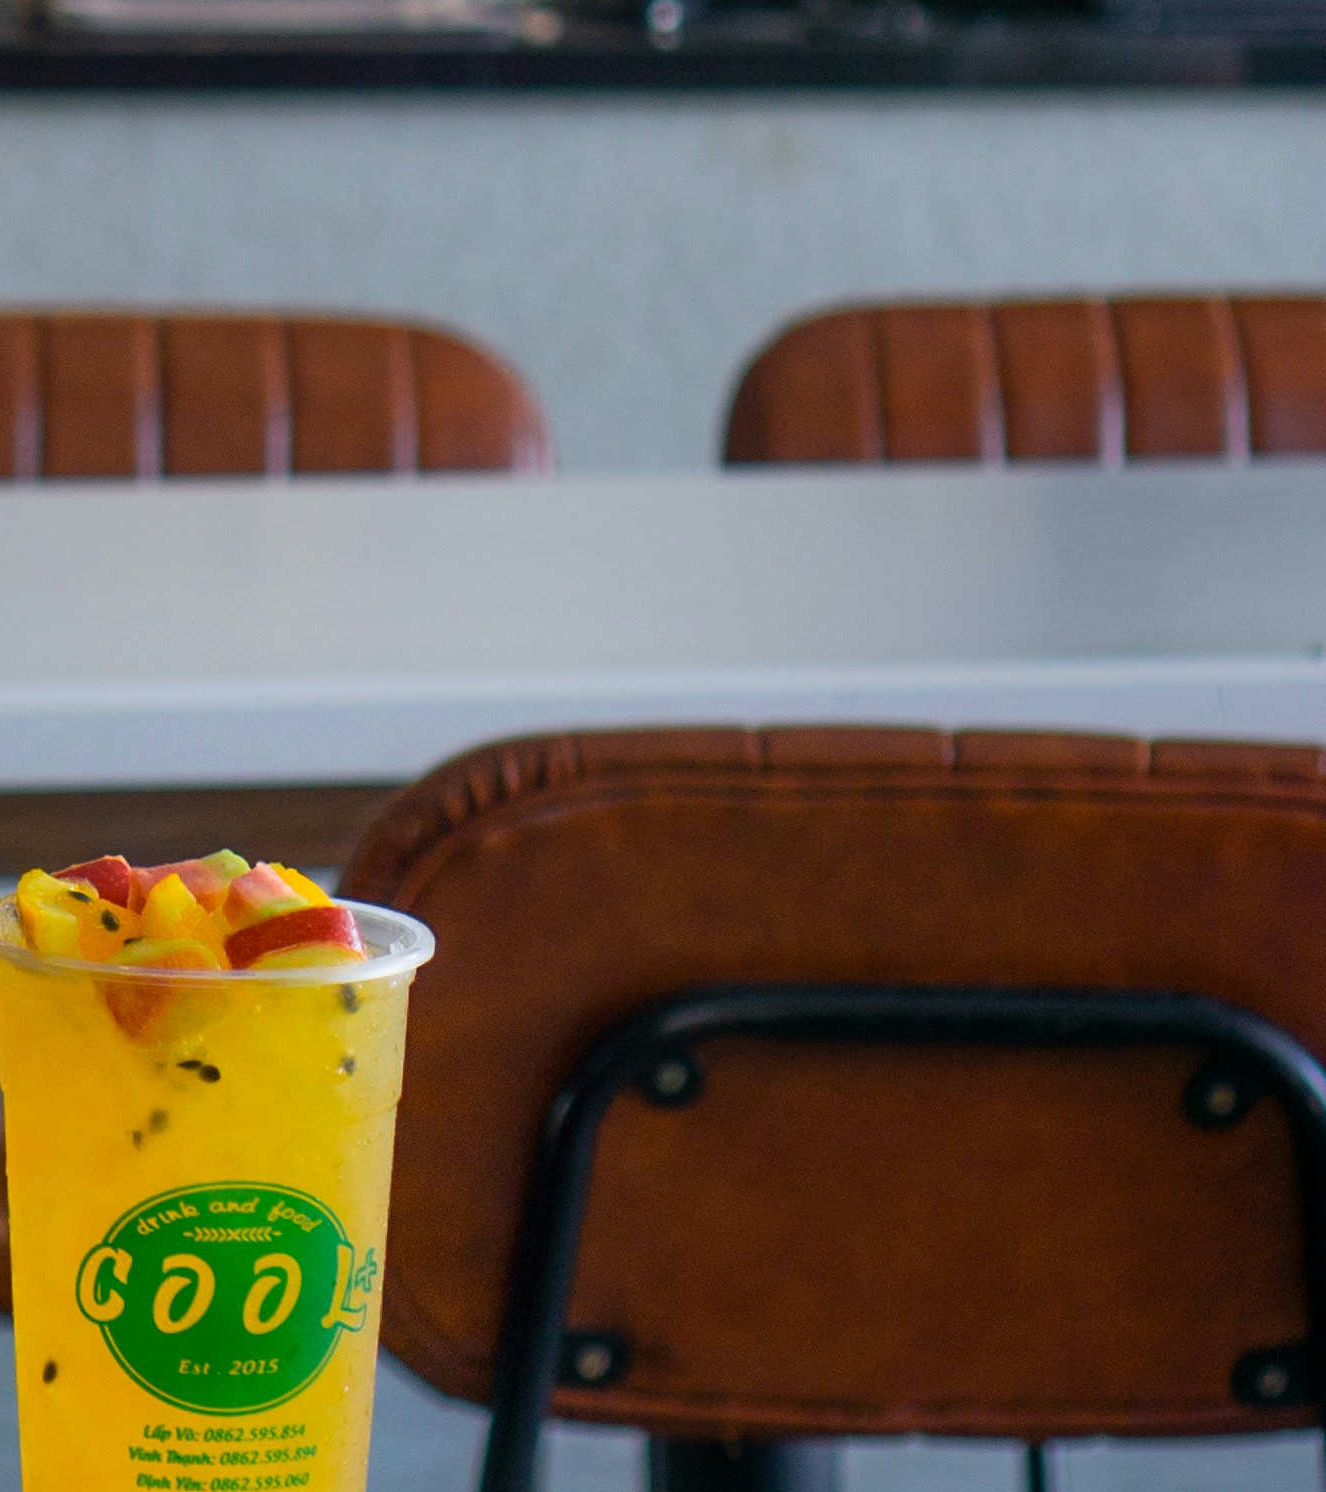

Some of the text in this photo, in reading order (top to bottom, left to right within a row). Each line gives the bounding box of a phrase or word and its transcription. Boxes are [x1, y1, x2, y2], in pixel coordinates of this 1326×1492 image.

[136, 1196, 323, 1236] drink and food
[229, 1359, 280, 1376] 2015
[204, 1423, 307, 1443] 0862.595.854
